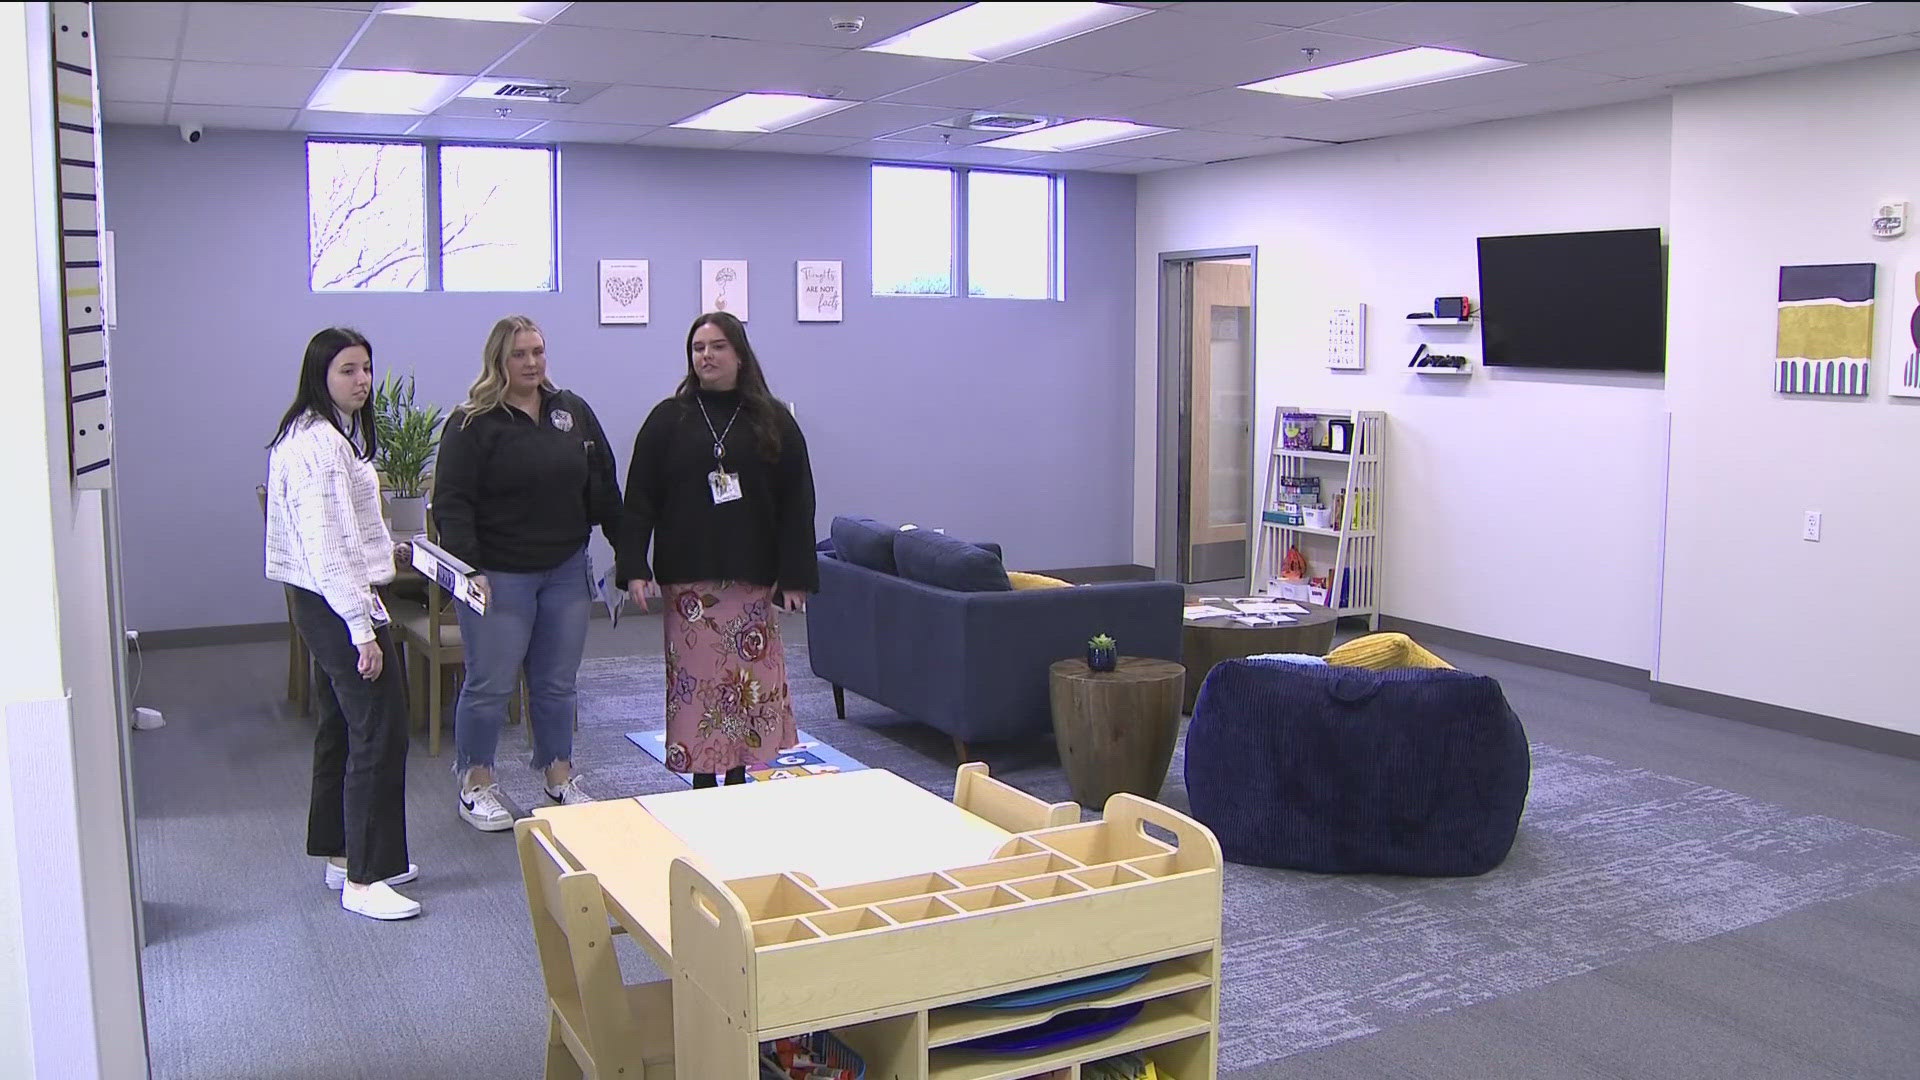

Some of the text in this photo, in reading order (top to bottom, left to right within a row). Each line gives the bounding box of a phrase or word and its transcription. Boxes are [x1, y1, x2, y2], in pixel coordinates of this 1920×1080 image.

[800, 266, 836, 283] Thoughts
[818, 291, 839, 313] facts
[776, 755, 806, 765] 6
